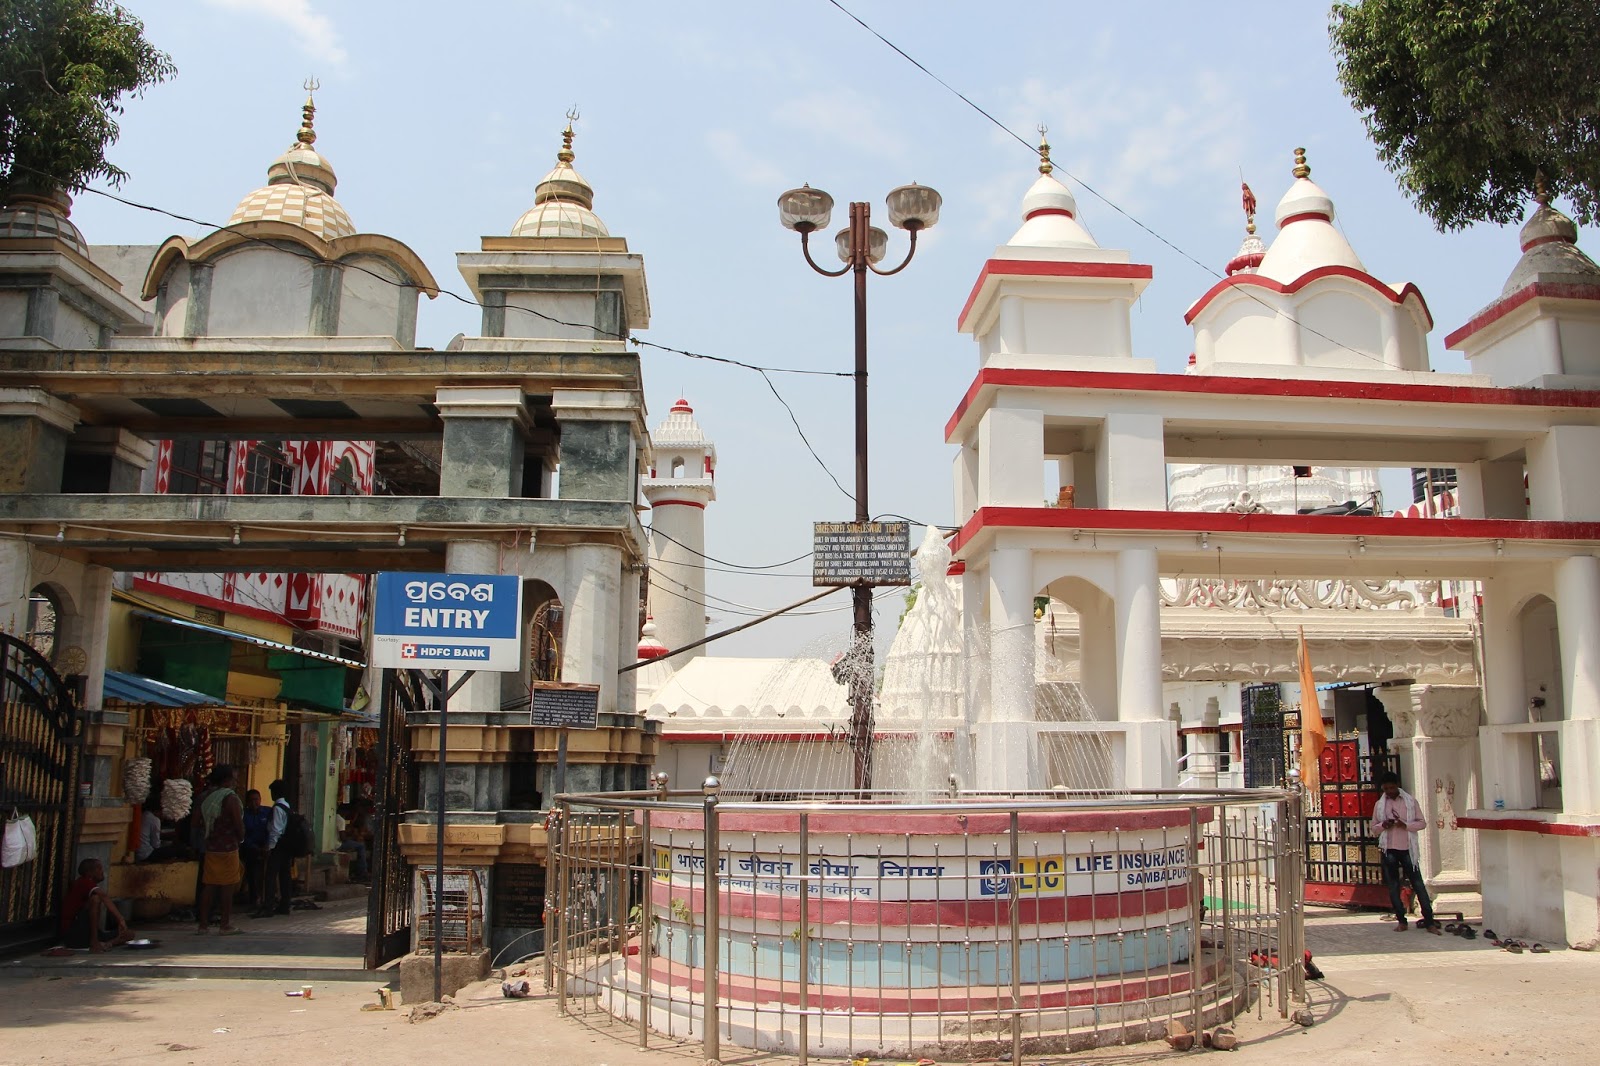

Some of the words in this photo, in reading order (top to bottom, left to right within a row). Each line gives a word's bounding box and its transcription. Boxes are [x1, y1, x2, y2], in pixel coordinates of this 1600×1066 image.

[405, 581, 493, 603] ପ୍ରବେଶ
[405, 608, 490, 629] ENTRY
[420, 648, 450, 656] HDFC
[454, 648, 485, 657] BANK
[1076, 855, 1113, 871] LIFE
[1119, 849, 1184, 869] INSURANCE
[1019, 860, 1058, 889] LIC
[1127, 868, 1187, 885] SAMBALPUR
